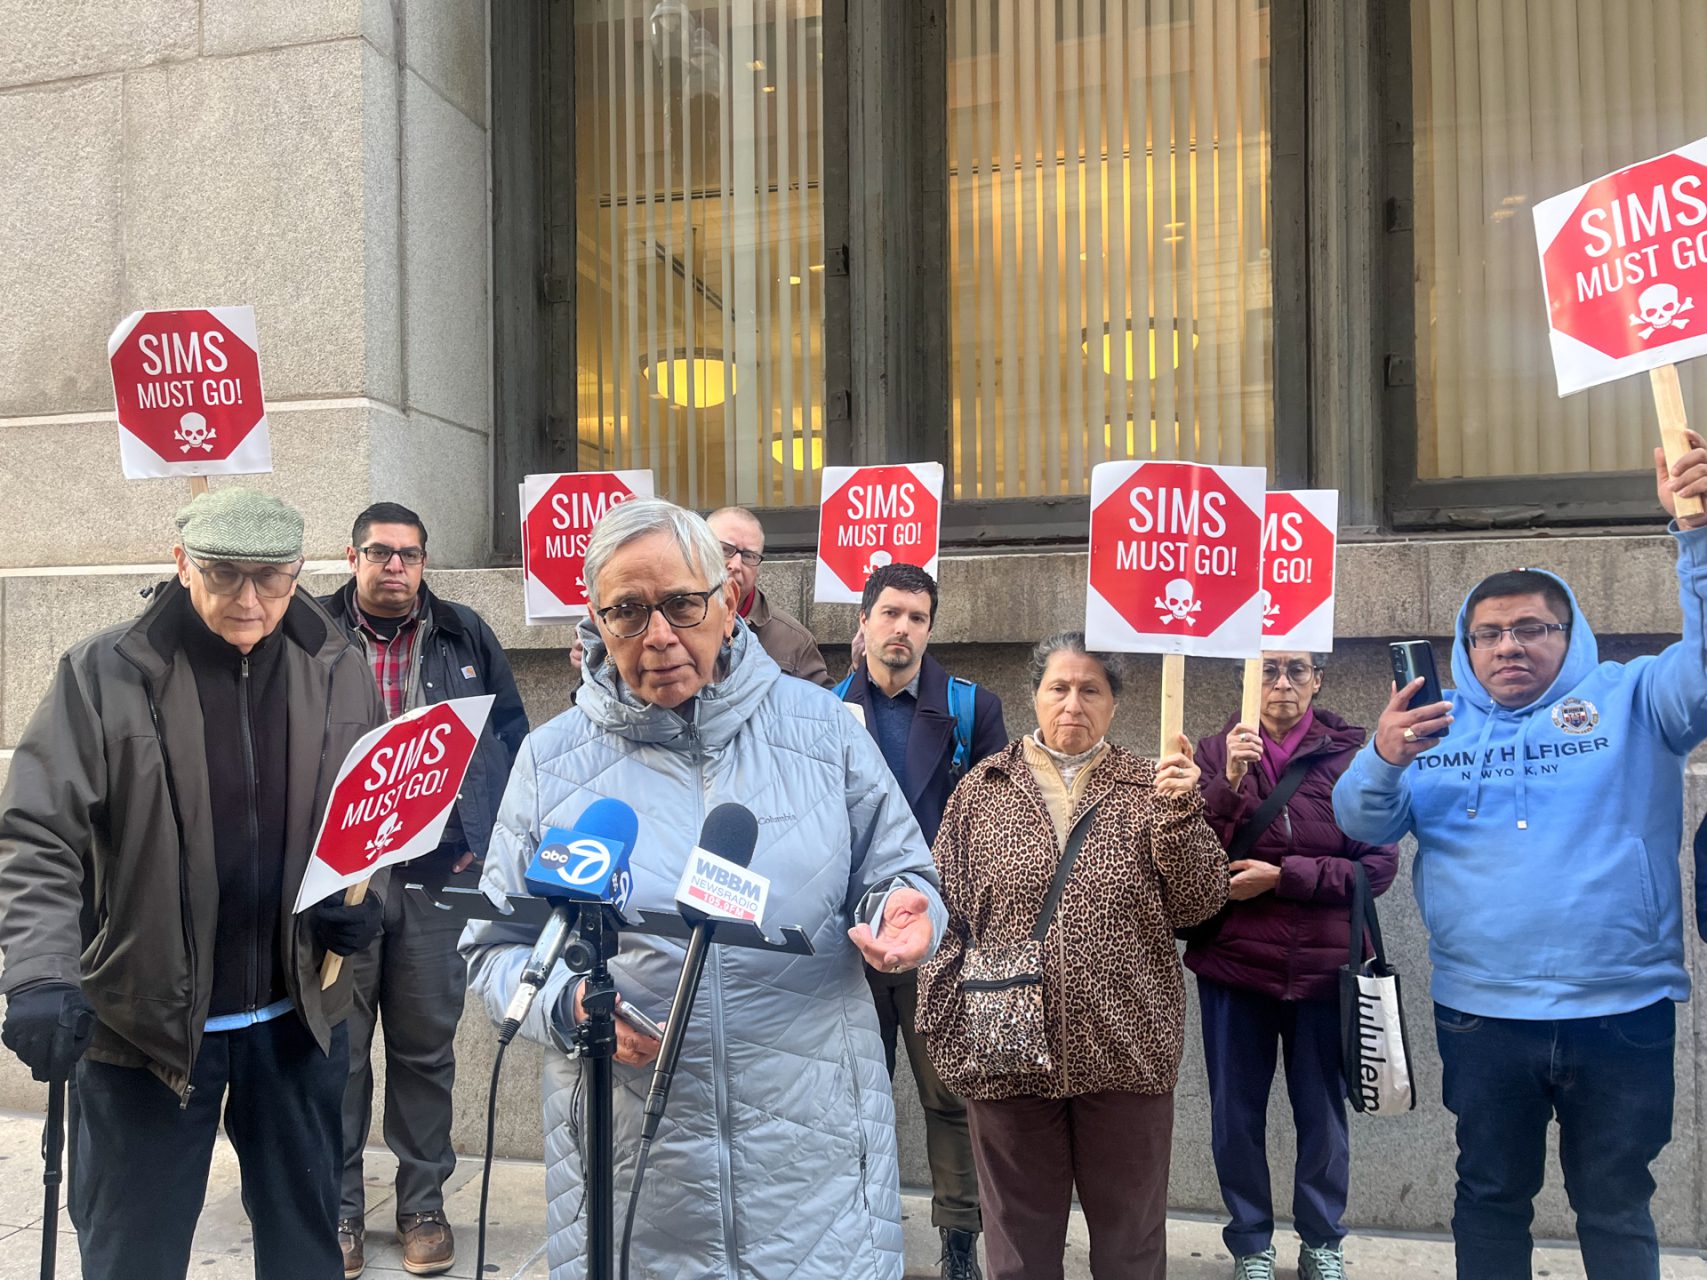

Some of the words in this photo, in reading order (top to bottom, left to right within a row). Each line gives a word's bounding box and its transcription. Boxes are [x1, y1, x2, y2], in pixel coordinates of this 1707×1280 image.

[1580, 174, 1707, 258] SIMS
[1576, 244, 1660, 303] MUST
[138, 330, 229, 376] SIMS
[136, 380, 194, 410] MUST
[202, 378, 243, 406] GO!
[847, 482, 915, 520] SIMS
[1128, 486, 1227, 539] SIMS
[545, 533, 592, 559] MUS
[837, 524, 888, 547] MUST
[893, 522, 922, 546] GO!
[1116, 540, 1189, 572] MUST
[1194, 544, 1237, 577] GO!
[1272, 557, 1312, 584] GO!
[364, 723, 452, 792] SIMS
[1415, 748, 1494, 771] TOMMY
[1501, 737, 1610, 763] HLFIGER
[1461, 769, 1492, 781] NW
[1495, 765, 1538, 777] YOK,
[1541, 764, 1559, 775] NY
[341, 781, 408, 830] MUST
[405, 767, 450, 800] GO!
[758, 812, 797, 826] Columbia
[541, 849, 569, 863] abc
[691, 875, 758, 912] NEWSRADIO
[696, 858, 761, 902] WBBM
